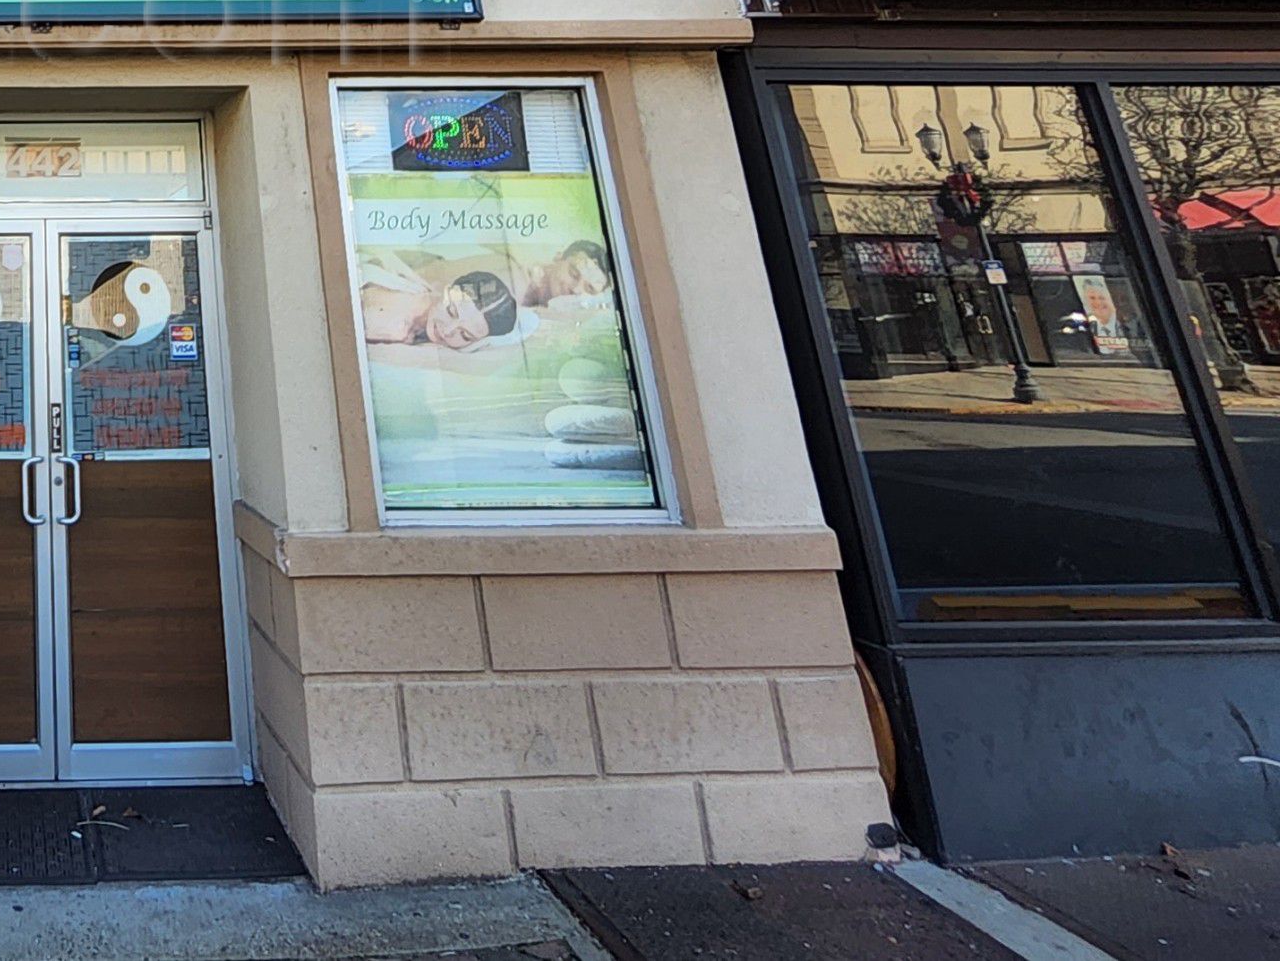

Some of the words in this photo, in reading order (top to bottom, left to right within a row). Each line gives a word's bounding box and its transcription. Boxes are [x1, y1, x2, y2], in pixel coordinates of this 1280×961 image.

[404, 113, 514, 152] OPEN
[6, 147, 80, 178] 442
[368, 207, 431, 238] Body
[439, 209, 550, 238] Massage
[175, 344, 194, 353] VISA
[52, 406, 61, 449] PULL
